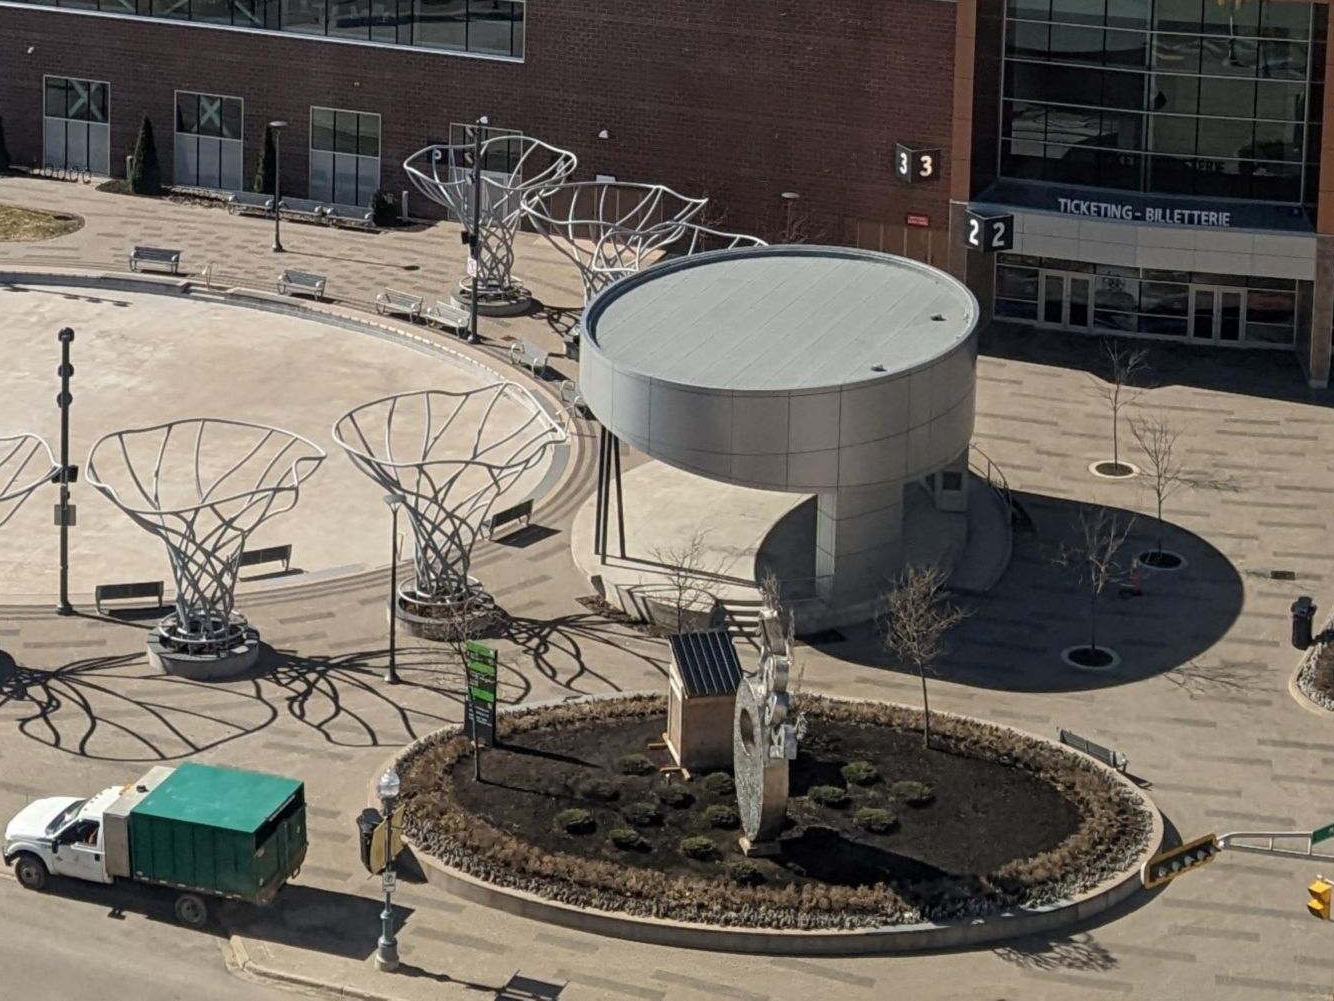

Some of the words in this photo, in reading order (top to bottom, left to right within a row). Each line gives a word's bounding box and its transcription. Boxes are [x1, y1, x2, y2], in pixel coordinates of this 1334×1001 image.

[899, 152, 908, 176] 3
[919, 155, 933, 177] 3
[1058, 198, 1133, 220] TICKETING
[1145, 207, 1231, 227] BILLETTERIE
[969, 218, 979, 247] 2
[992, 221, 1006, 248] 2
